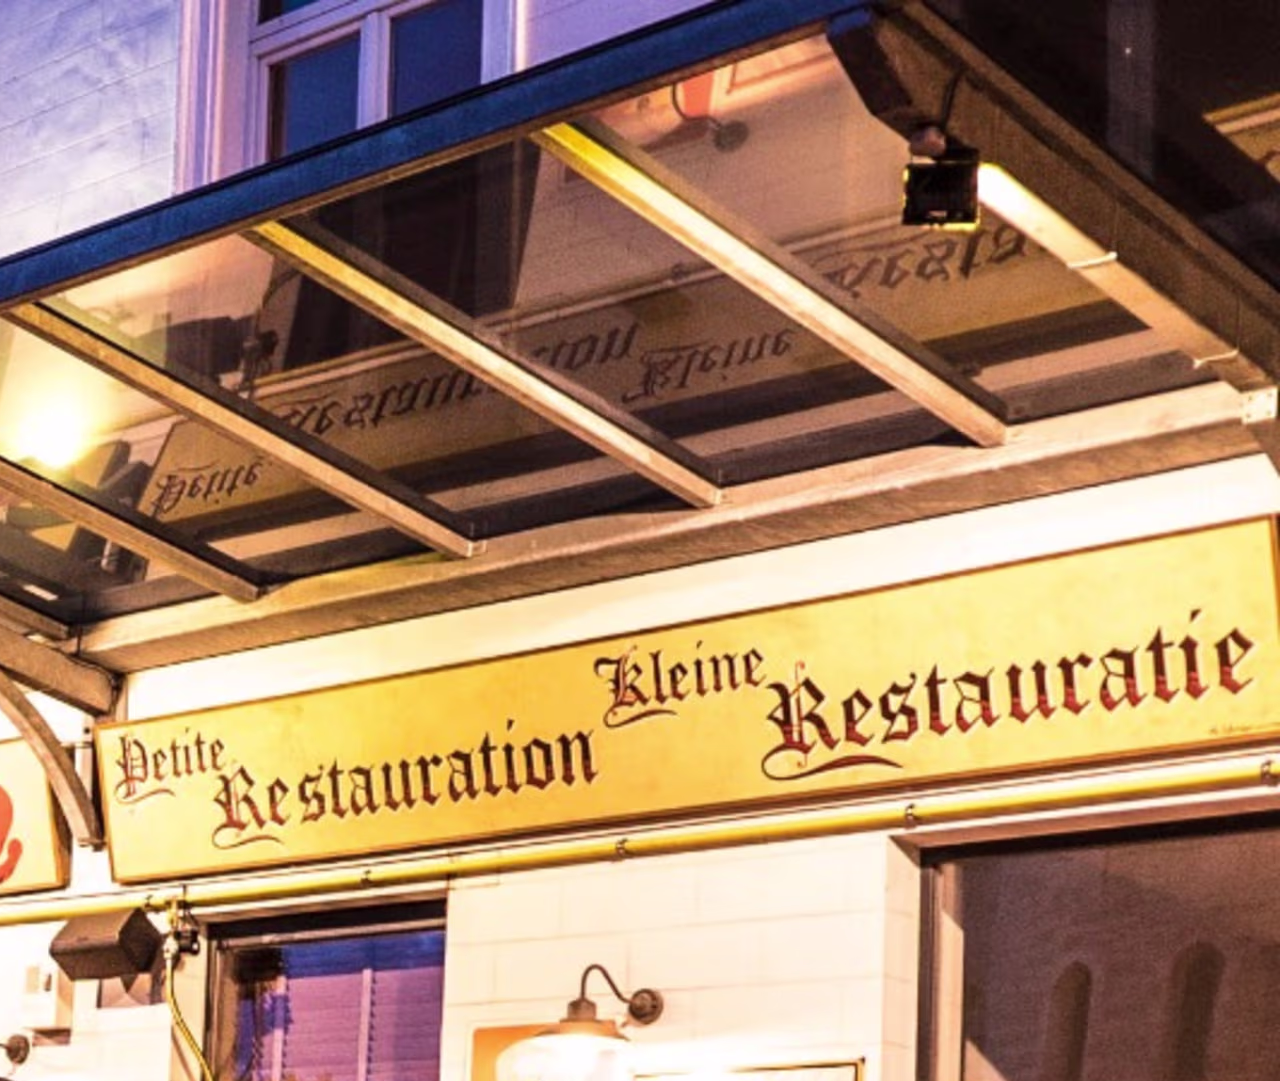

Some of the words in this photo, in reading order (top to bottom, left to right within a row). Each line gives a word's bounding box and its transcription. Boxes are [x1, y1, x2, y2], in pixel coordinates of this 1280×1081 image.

[593, 640, 768, 729] Kleine
[761, 608, 1255, 781] Restauratie
[113, 728, 226, 805] Petite
[212, 719, 600, 849] Restauration
